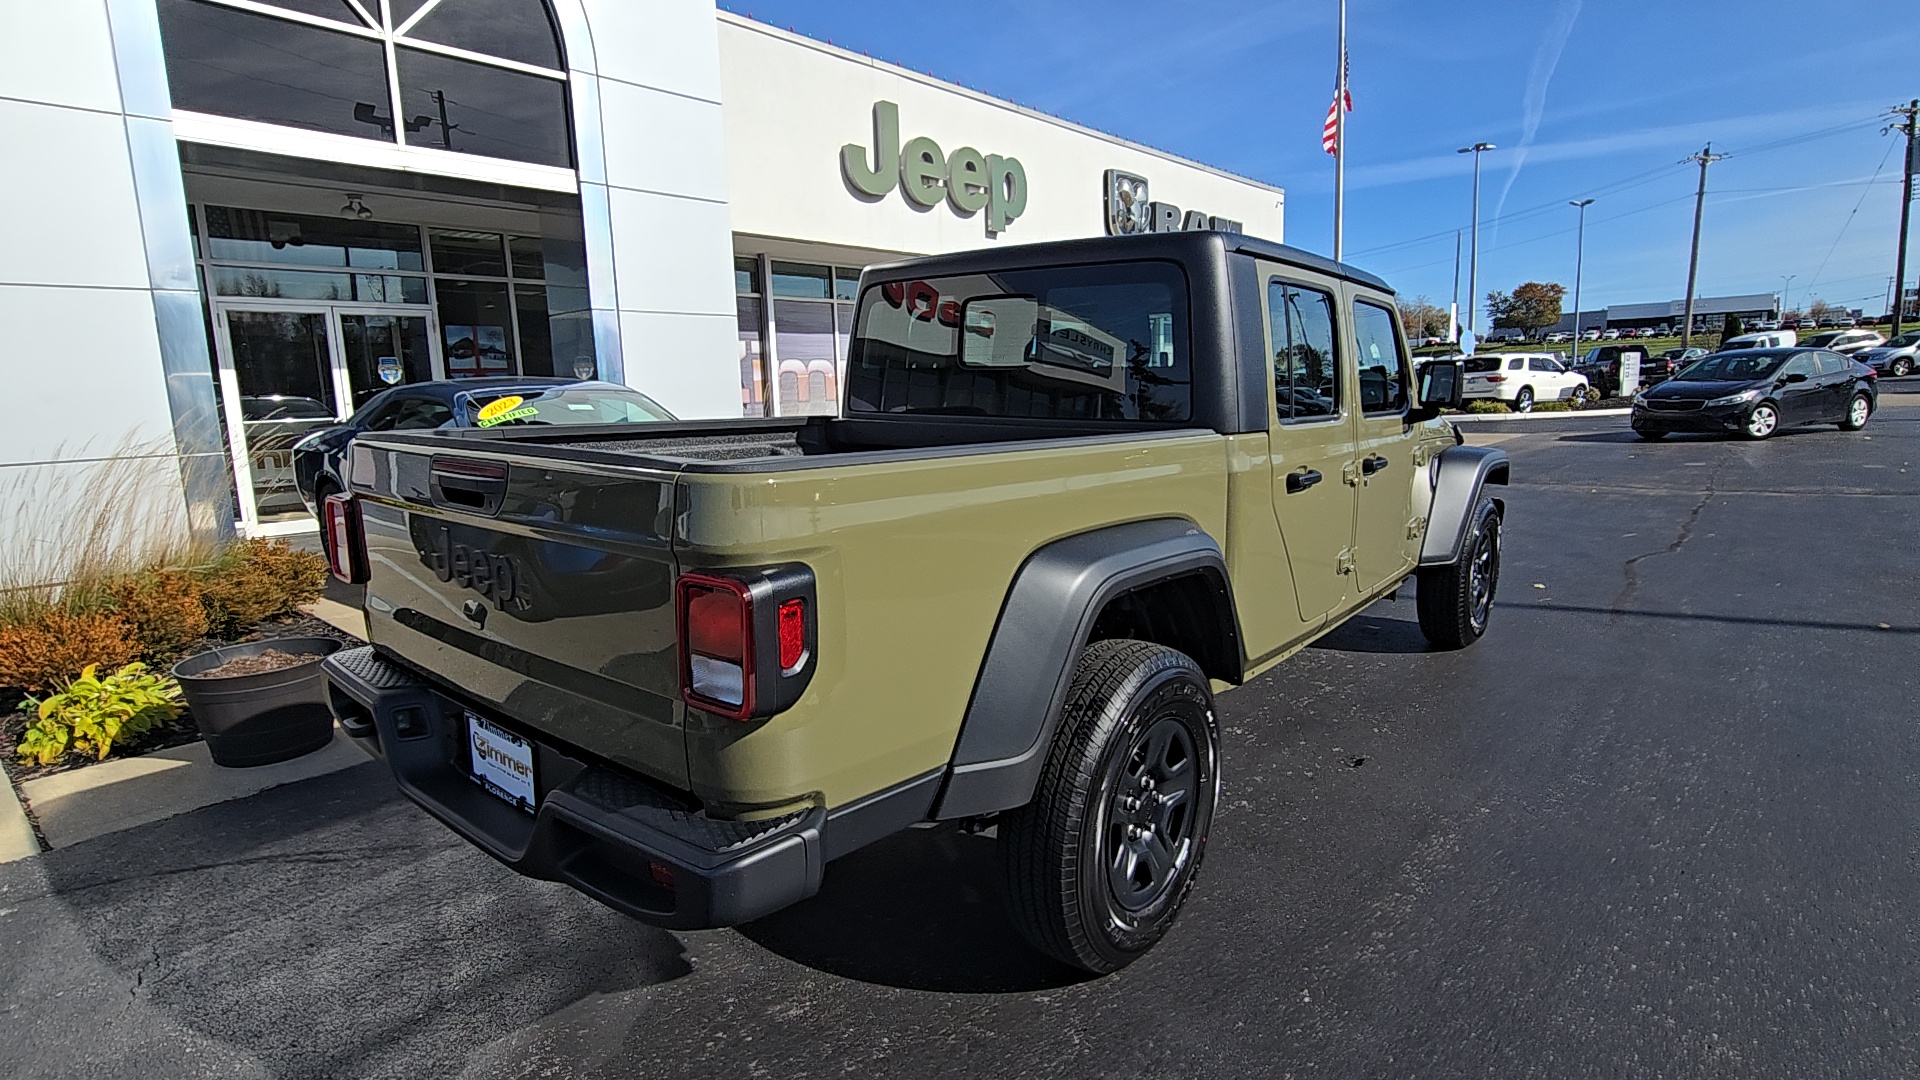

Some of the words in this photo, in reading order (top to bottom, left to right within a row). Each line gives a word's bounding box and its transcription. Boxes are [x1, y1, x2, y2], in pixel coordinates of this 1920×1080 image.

[839, 100, 1027, 234] Jeep
[1150, 201, 1243, 234] RAM
[481, 408, 535, 428] CERTIFIED
[486, 397, 516, 417] 2023
[431, 526, 515, 611] Jeep
